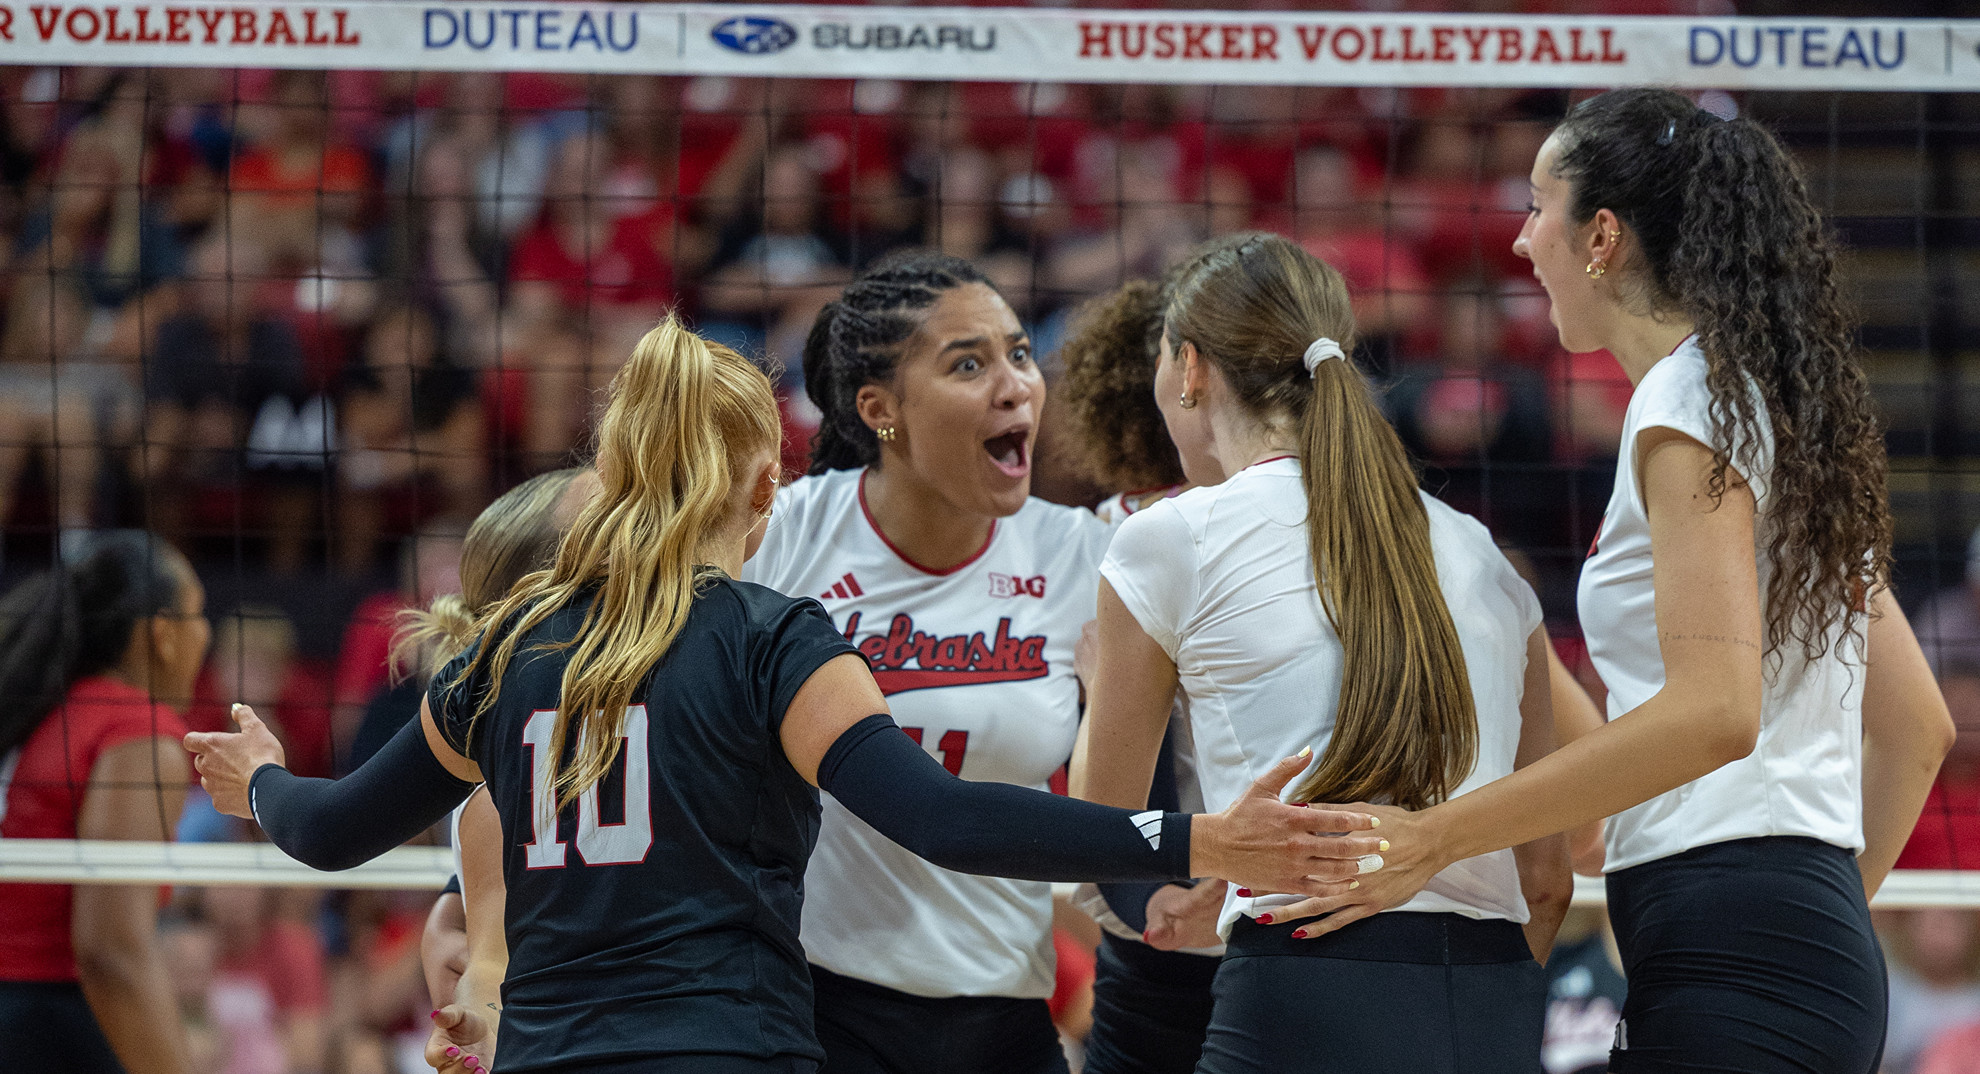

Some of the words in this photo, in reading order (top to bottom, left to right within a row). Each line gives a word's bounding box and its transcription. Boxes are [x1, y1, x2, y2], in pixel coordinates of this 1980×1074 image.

[30, 7, 360, 45] VOLLEYBALL
[422, 9, 640, 52] DUTEAU
[811, 24, 996, 53] SUBARU
[1077, 22, 1279, 60] HUSKER
[1298, 26, 1627, 64] VOLLEYBALL
[1688, 27, 1905, 69] DUTEAU
[522, 702, 654, 871] 10
